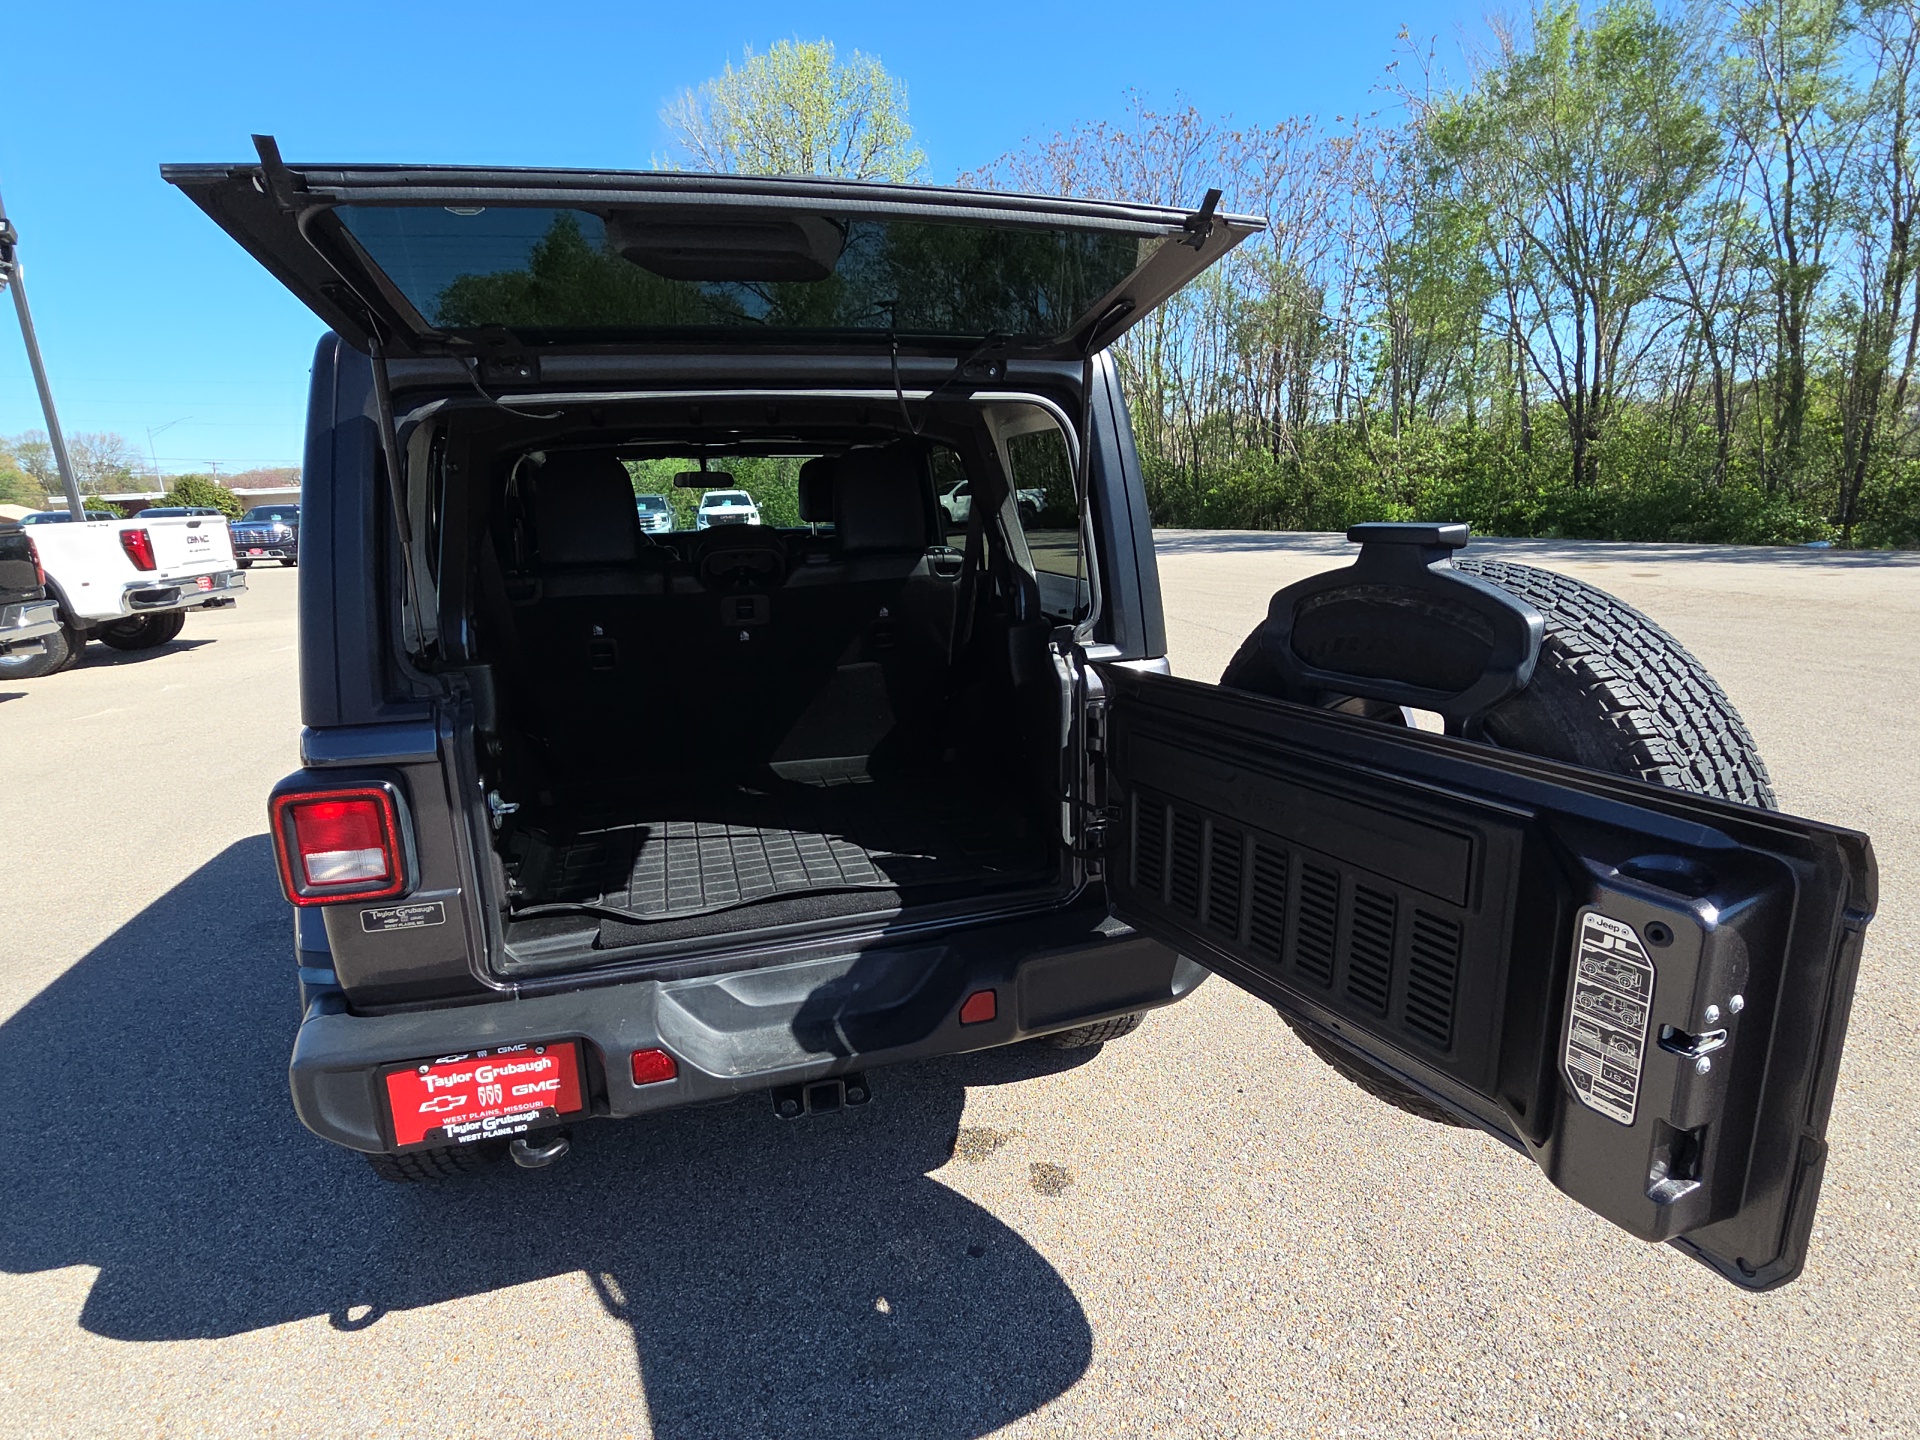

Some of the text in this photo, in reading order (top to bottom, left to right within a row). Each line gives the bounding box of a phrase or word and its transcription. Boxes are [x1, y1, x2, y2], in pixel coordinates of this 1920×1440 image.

[370, 906, 434, 920] Taylor Grubaugh
[1596, 919, 1620, 933] Jeep
[1584, 934, 1643, 958] JL
[497, 1043, 527, 1054] GMC
[420, 1058, 551, 1093] Taylor Grubaugh
[511, 1079, 560, 1096] GMC
[442, 1101, 543, 1124] WEST PLAINS, MISSOURI
[442, 1110, 540, 1138] Taylor Grubaugh
[458, 1124, 528, 1143] WEST PLAINS, MO
